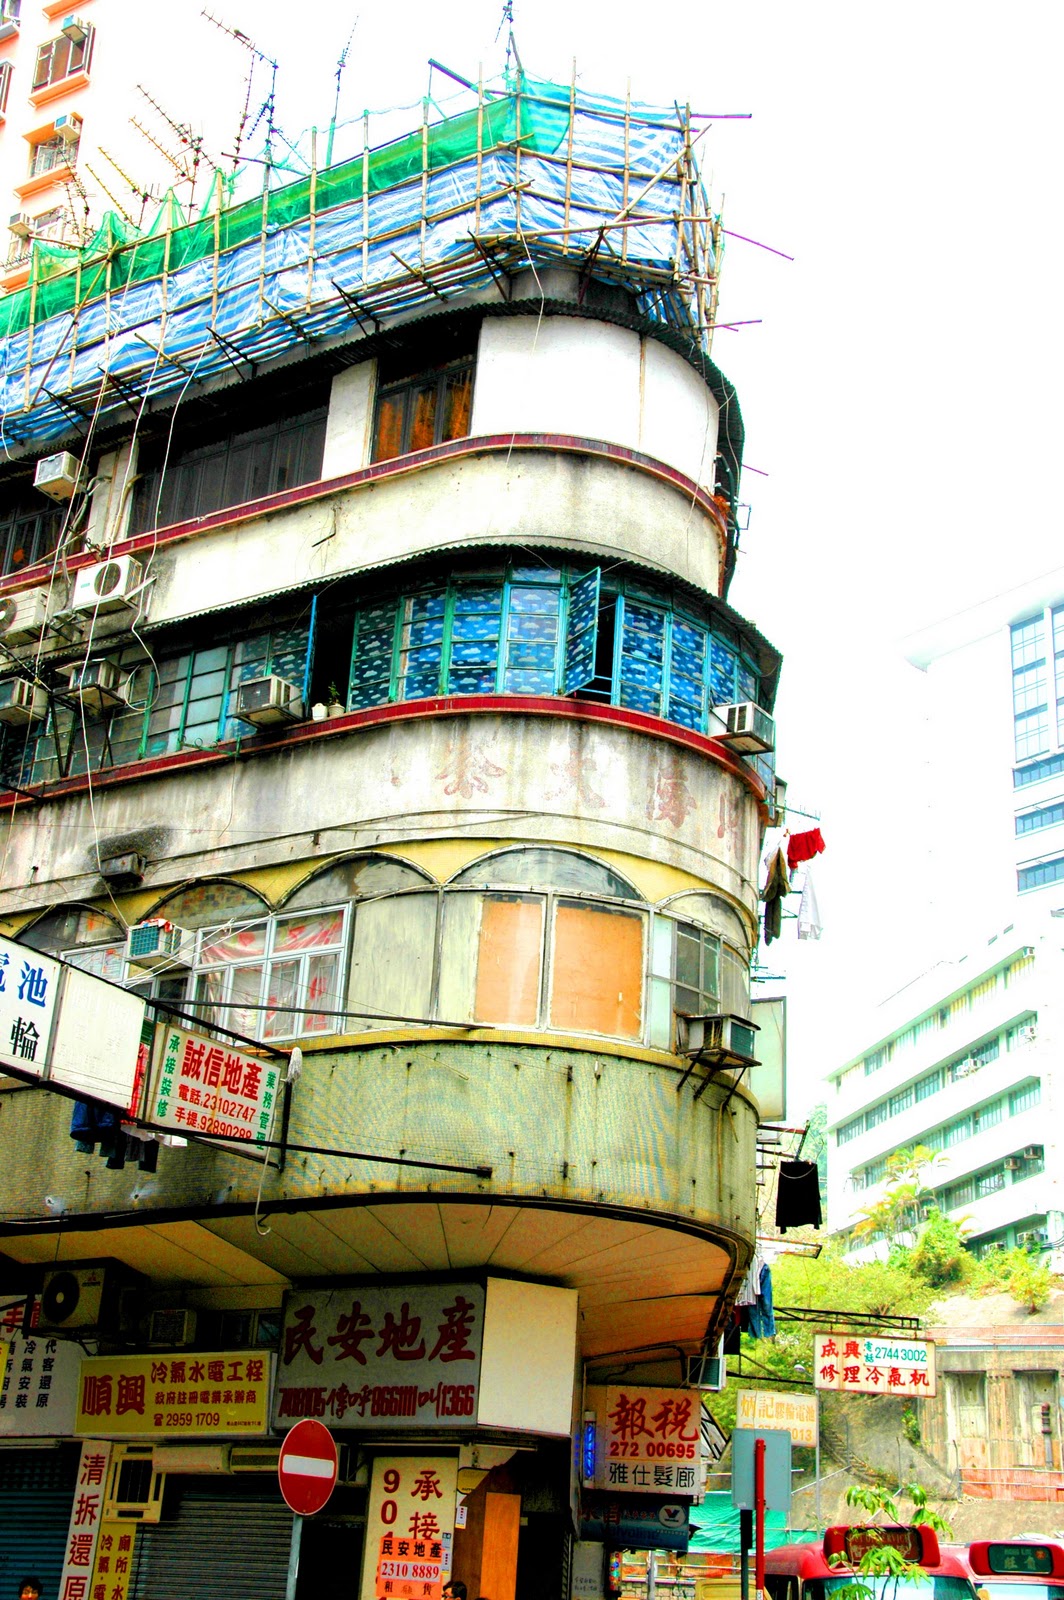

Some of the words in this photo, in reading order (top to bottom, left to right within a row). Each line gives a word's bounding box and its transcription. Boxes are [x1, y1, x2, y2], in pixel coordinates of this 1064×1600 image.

[157, 1034, 180, 1117] 承接裝修
[181, 1039, 262, 1102] 誠信地產
[256, 1071, 277, 1151] 業務管理
[283, 1295, 476, 1366] 民安地產
[15, 1340, 37, 1409] 冷氣安裝
[35, 1339, 57, 1408] 代客還原
[81, 1374, 146, 1416] 順興
[151, 1359, 264, 1384] 冷氣水電工程
[819, 1364, 930, 1387] 修理冷氣机
[609, 1441, 639, 1457] 272
[646, 1442, 695, 1459] 00695
[609, 1462, 695, 1488] 雅仕髮廊
[63, 1454, 106, 1600] 清拆還原
[381, 1539, 442, 1558] 民安地產
[381, 1562, 408, 1577] 2310
[412, 1564, 439, 1579] 8889
